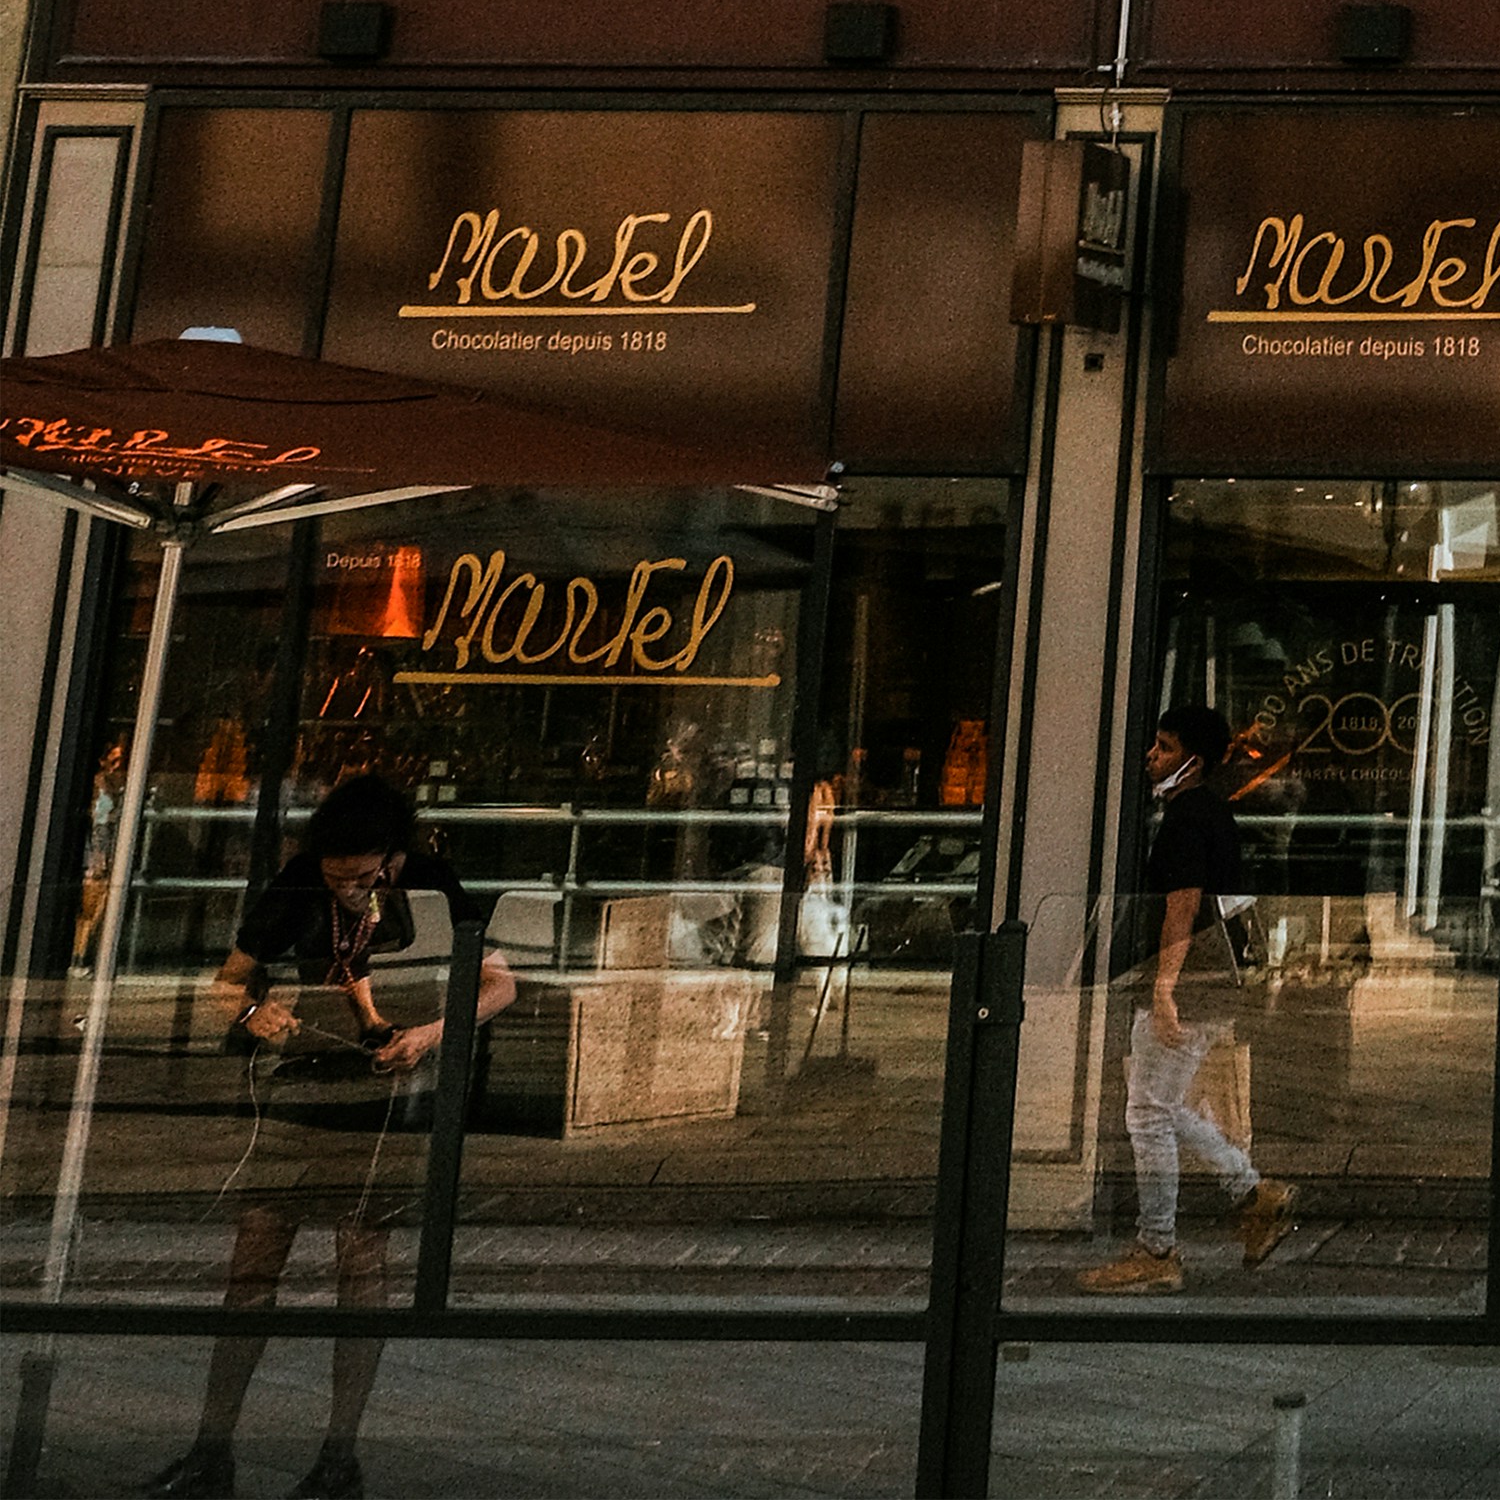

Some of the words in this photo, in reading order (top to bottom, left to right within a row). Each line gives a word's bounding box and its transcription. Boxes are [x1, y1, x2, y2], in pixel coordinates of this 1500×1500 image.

[428, 208, 713, 305] Martel
[432, 329, 543, 352] Chocolatier
[547, 331, 613, 357] depuis
[620, 331, 668, 352] 1818
[1242, 334, 1355, 358] Chocolatier
[1359, 335, 1426, 361] depuis
[1433, 336, 1481, 358] 1818
[325, 552, 382, 570] Depuis
[422, 549, 735, 670] Martel
[1283, 649, 1335, 697] ANS
[1341, 638, 1376, 666] DE
[1387, 639, 1491, 747] TRTION
